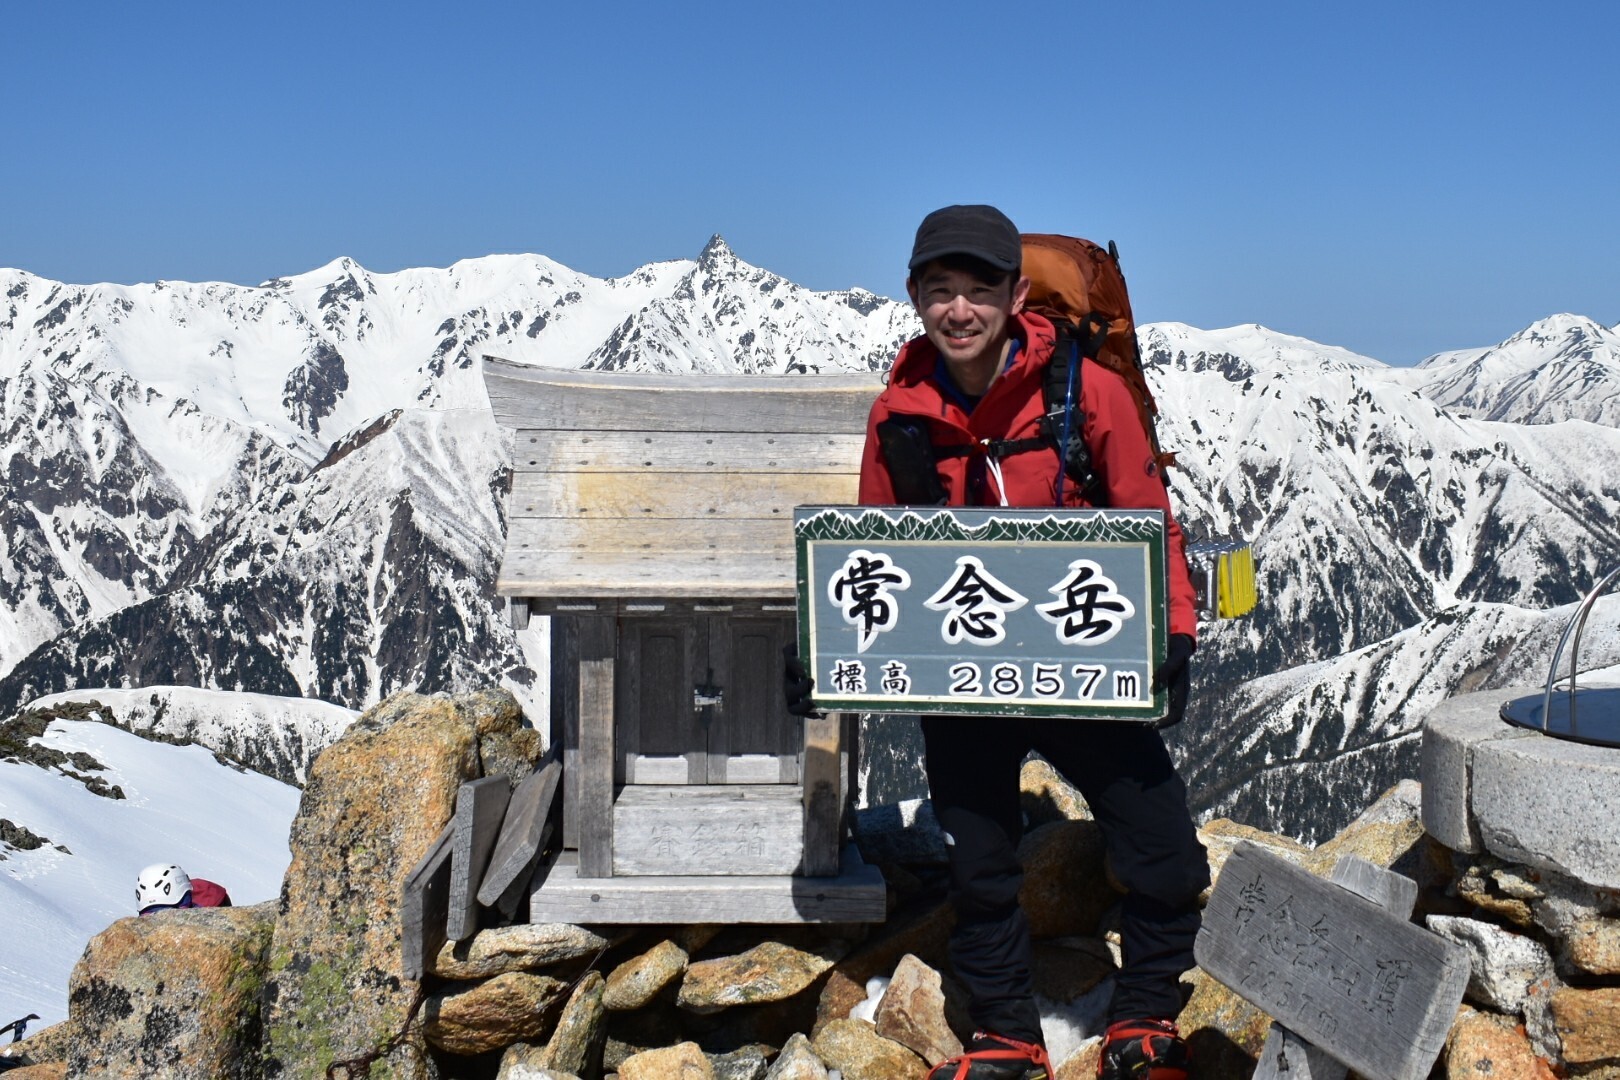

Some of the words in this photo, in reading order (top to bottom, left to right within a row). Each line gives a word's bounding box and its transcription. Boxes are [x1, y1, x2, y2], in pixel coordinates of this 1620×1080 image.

[828, 549, 1135, 653] 常念岳
[833, 660, 912, 694] 標高
[949, 662, 1138, 699] 2857m
